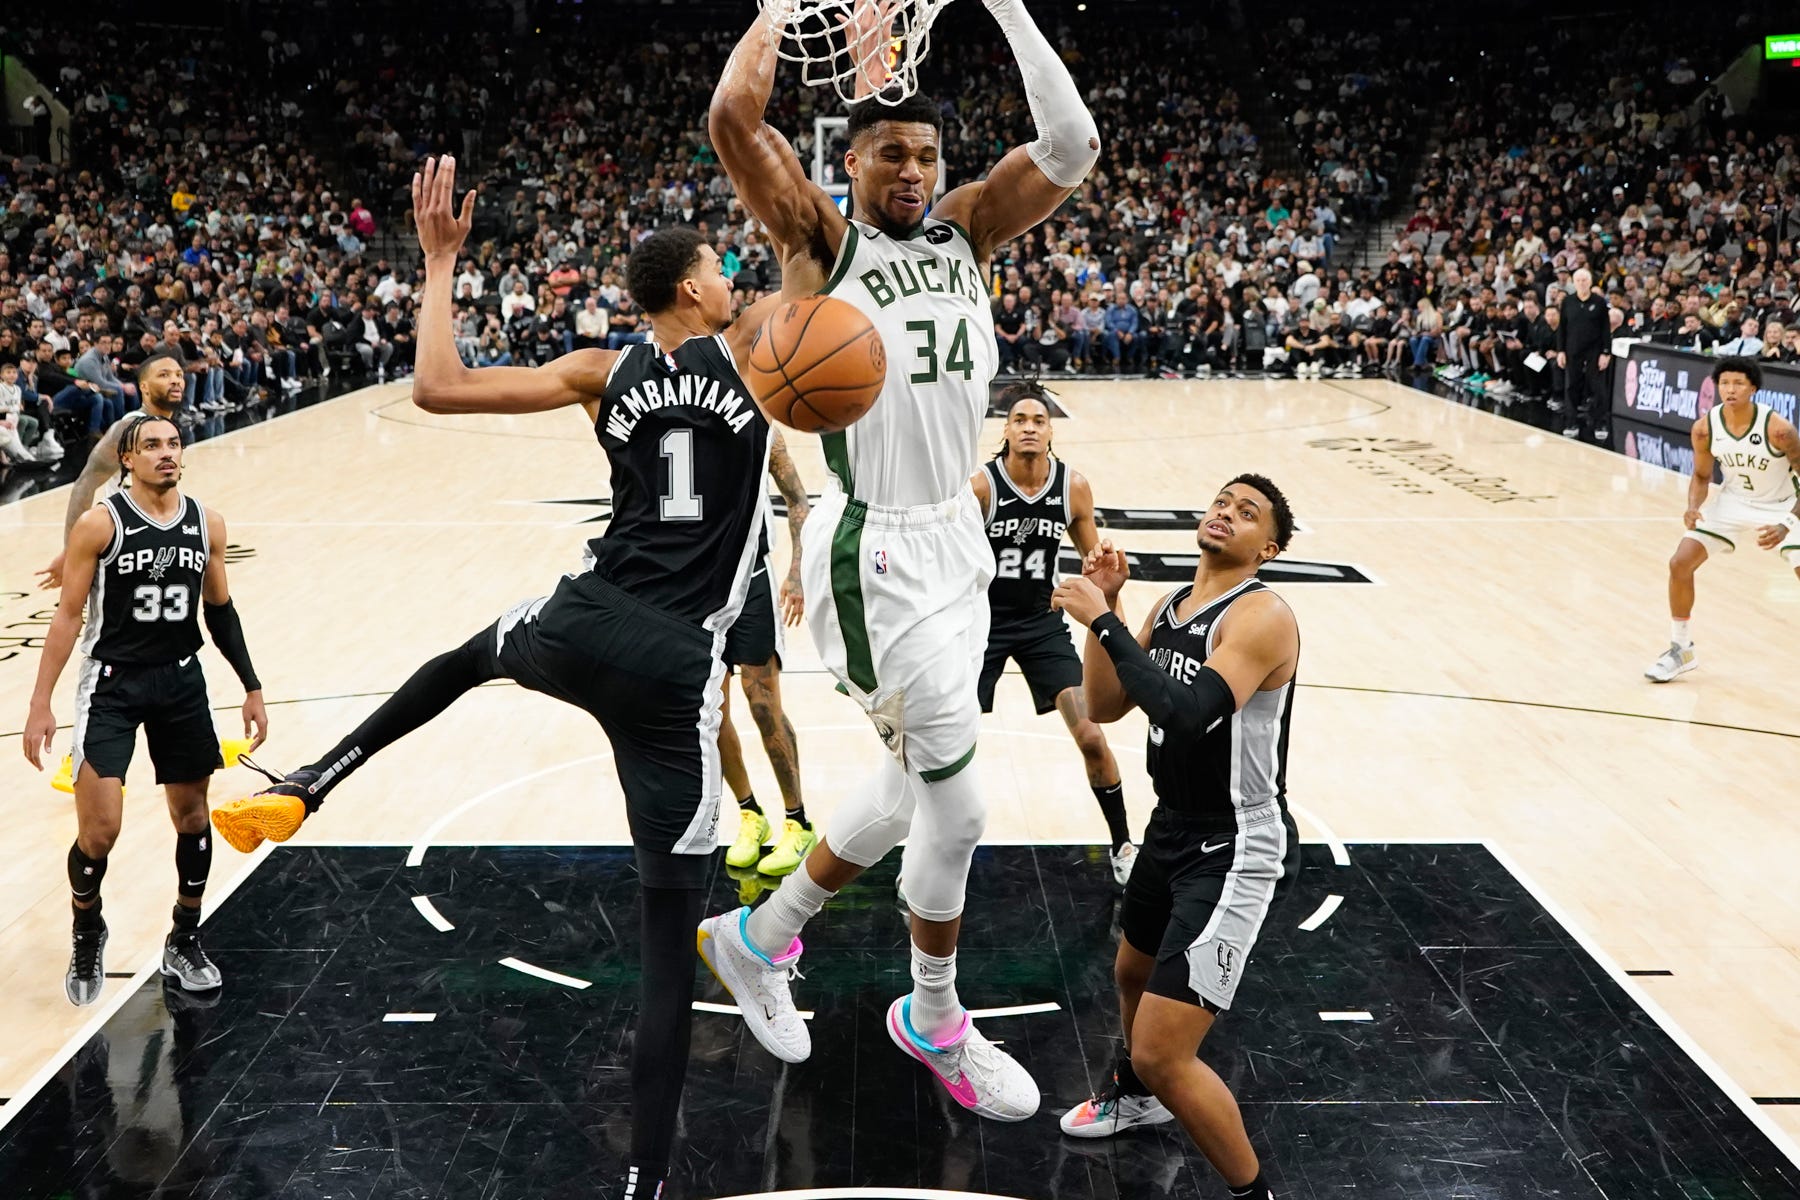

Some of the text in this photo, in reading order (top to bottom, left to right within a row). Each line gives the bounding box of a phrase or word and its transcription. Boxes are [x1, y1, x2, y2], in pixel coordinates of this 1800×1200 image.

[858, 257, 978, 309] BUCKS
[905, 318, 974, 384] 34
[605, 374, 755, 443] WEMBANYAMA
[659, 428, 703, 521] 1
[1738, 474, 1755, 491] 3
[989, 518, 1066, 545] SPURS
[118, 546, 205, 581] SPURS
[997, 548, 1047, 579] 24
[132, 583, 190, 622] 33
